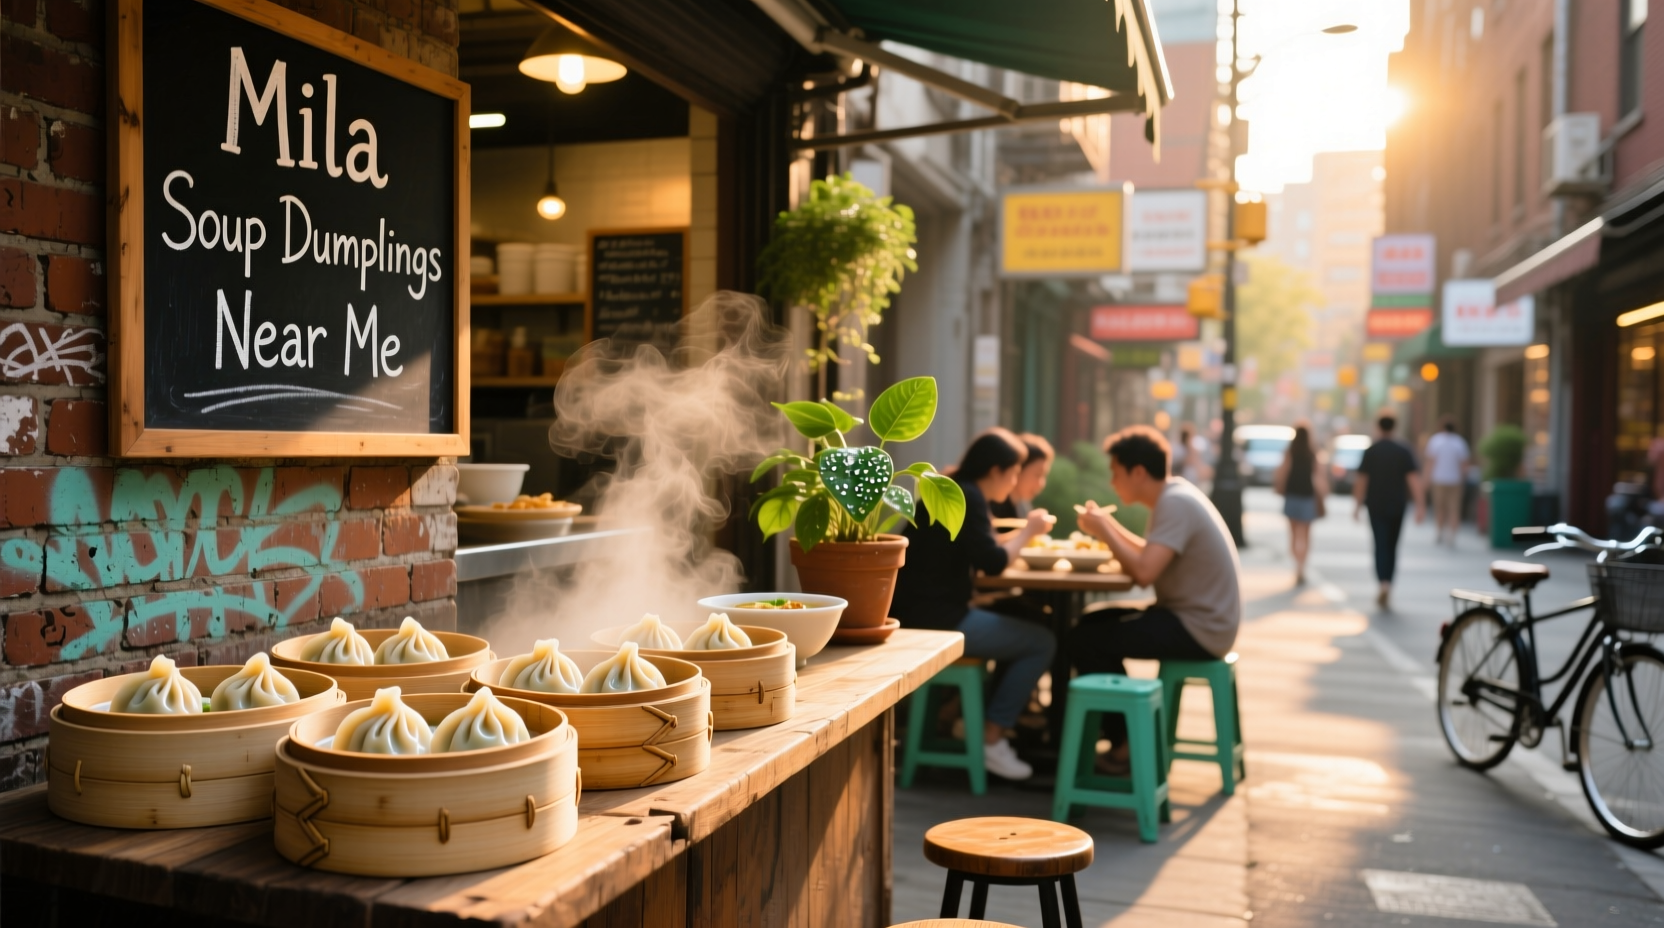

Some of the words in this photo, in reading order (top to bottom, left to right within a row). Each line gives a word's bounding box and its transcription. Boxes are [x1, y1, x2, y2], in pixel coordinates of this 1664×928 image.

[220, 46, 389, 189] Mila
[161, 170, 267, 278] Soup
[279, 195, 442, 301] Dumplings
[215, 288, 328, 370] Near
[344, 302, 404, 378] Me
